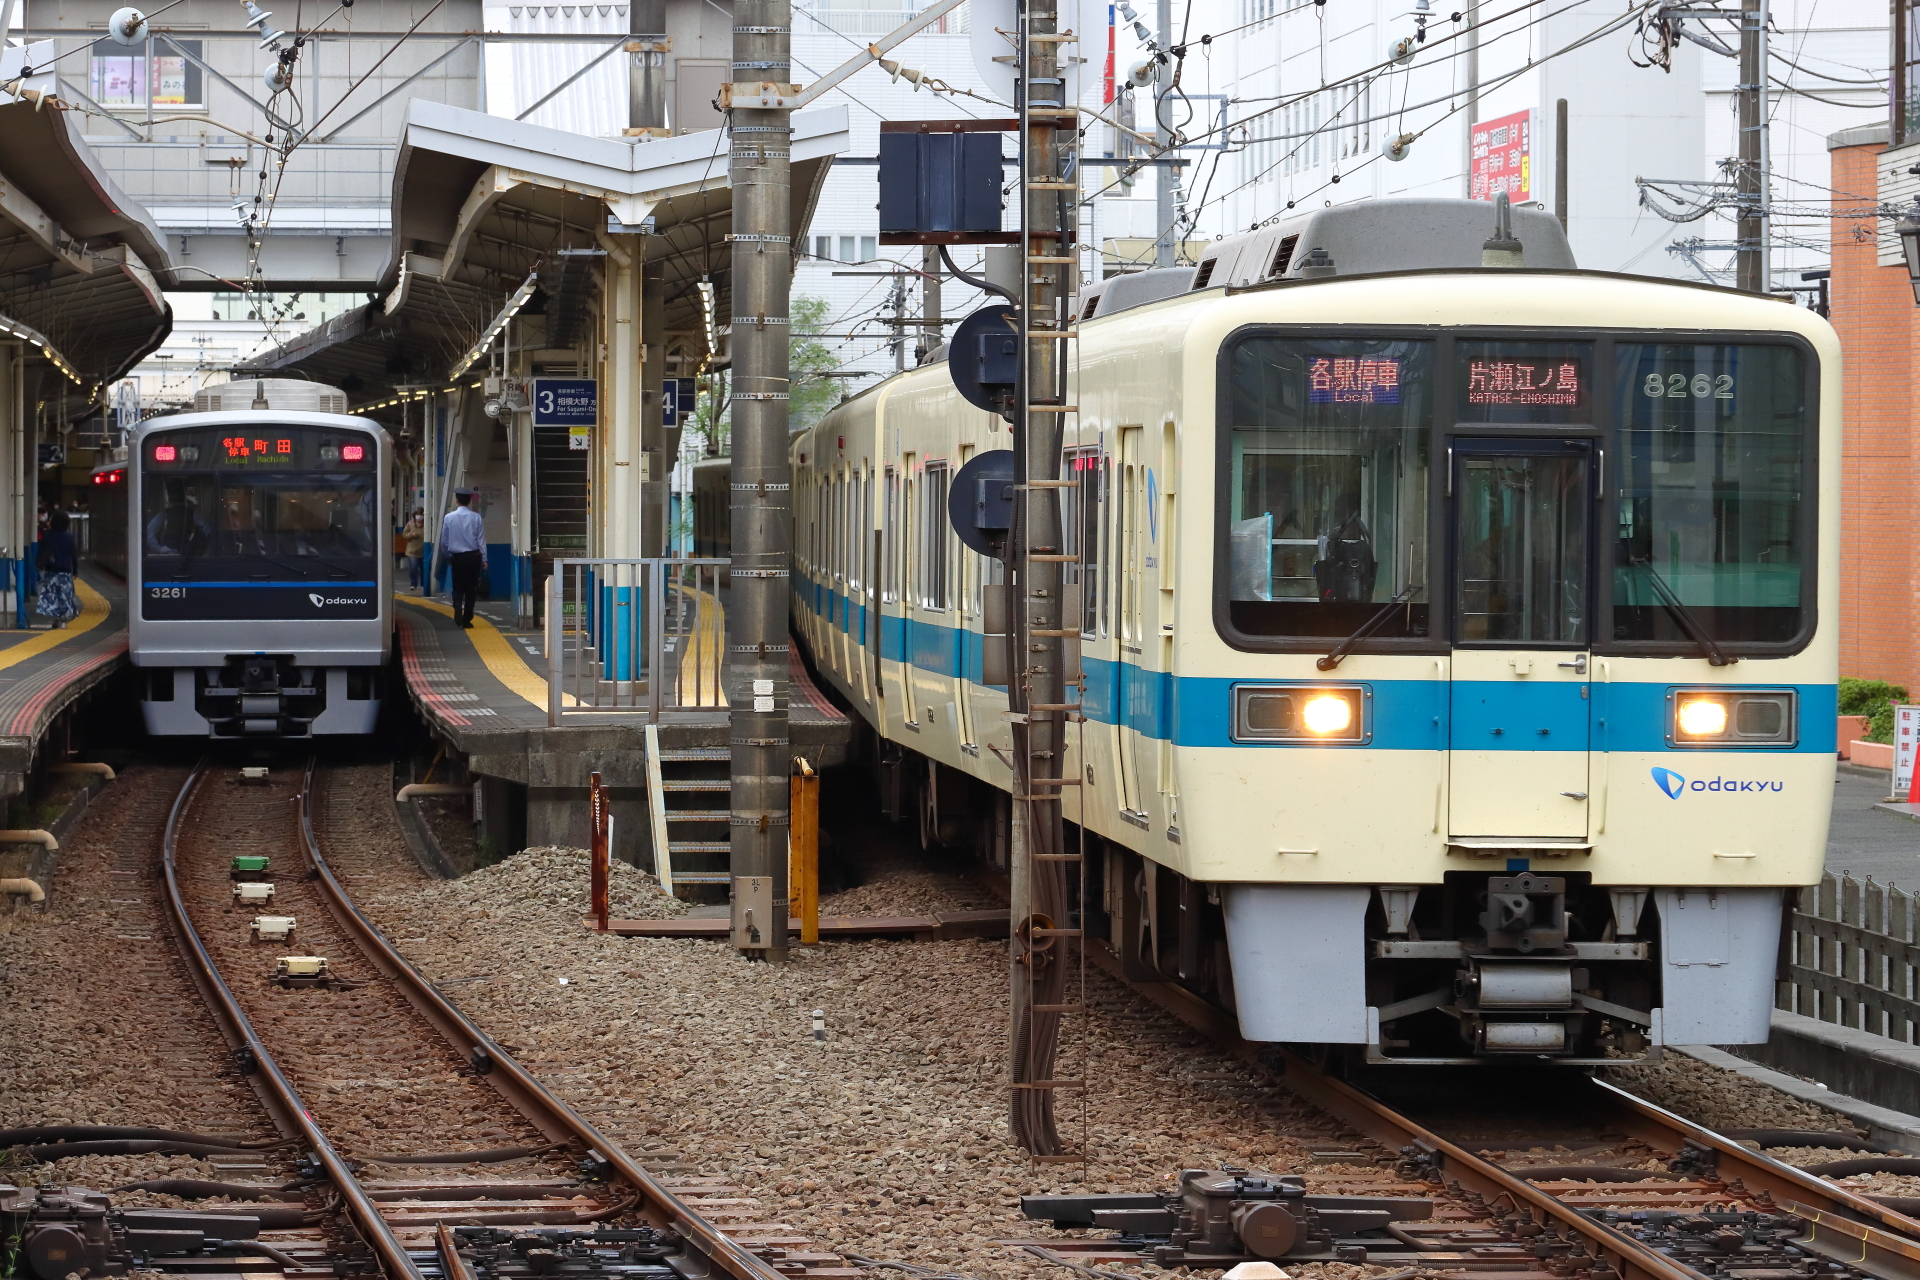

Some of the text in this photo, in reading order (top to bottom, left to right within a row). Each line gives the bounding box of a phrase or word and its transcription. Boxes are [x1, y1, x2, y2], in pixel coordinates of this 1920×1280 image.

[1310, 358, 1399, 391] 各駅停車
[1469, 361, 1578, 391] 片瀬江ノ島
[1644, 373, 1734, 398] 8262
[539, 391, 554, 414] 3
[557, 397, 588, 406] 相模大野
[662, 391, 674, 414] 4
[1335, 391, 1374, 402] Local
[1469, 392, 1577, 404] KATASE-ENOSHIMA
[222, 437, 245, 447] 各駅
[254, 439, 291, 454] 町田
[228, 447, 250, 457] 停車
[257, 455, 289, 463] Machida
[151, 588, 186, 599] 3261
[326, 596, 367, 605] odakyu
[1900, 711, 1911, 768] 駐車禁止
[1690, 775, 1783, 792] odakyu
